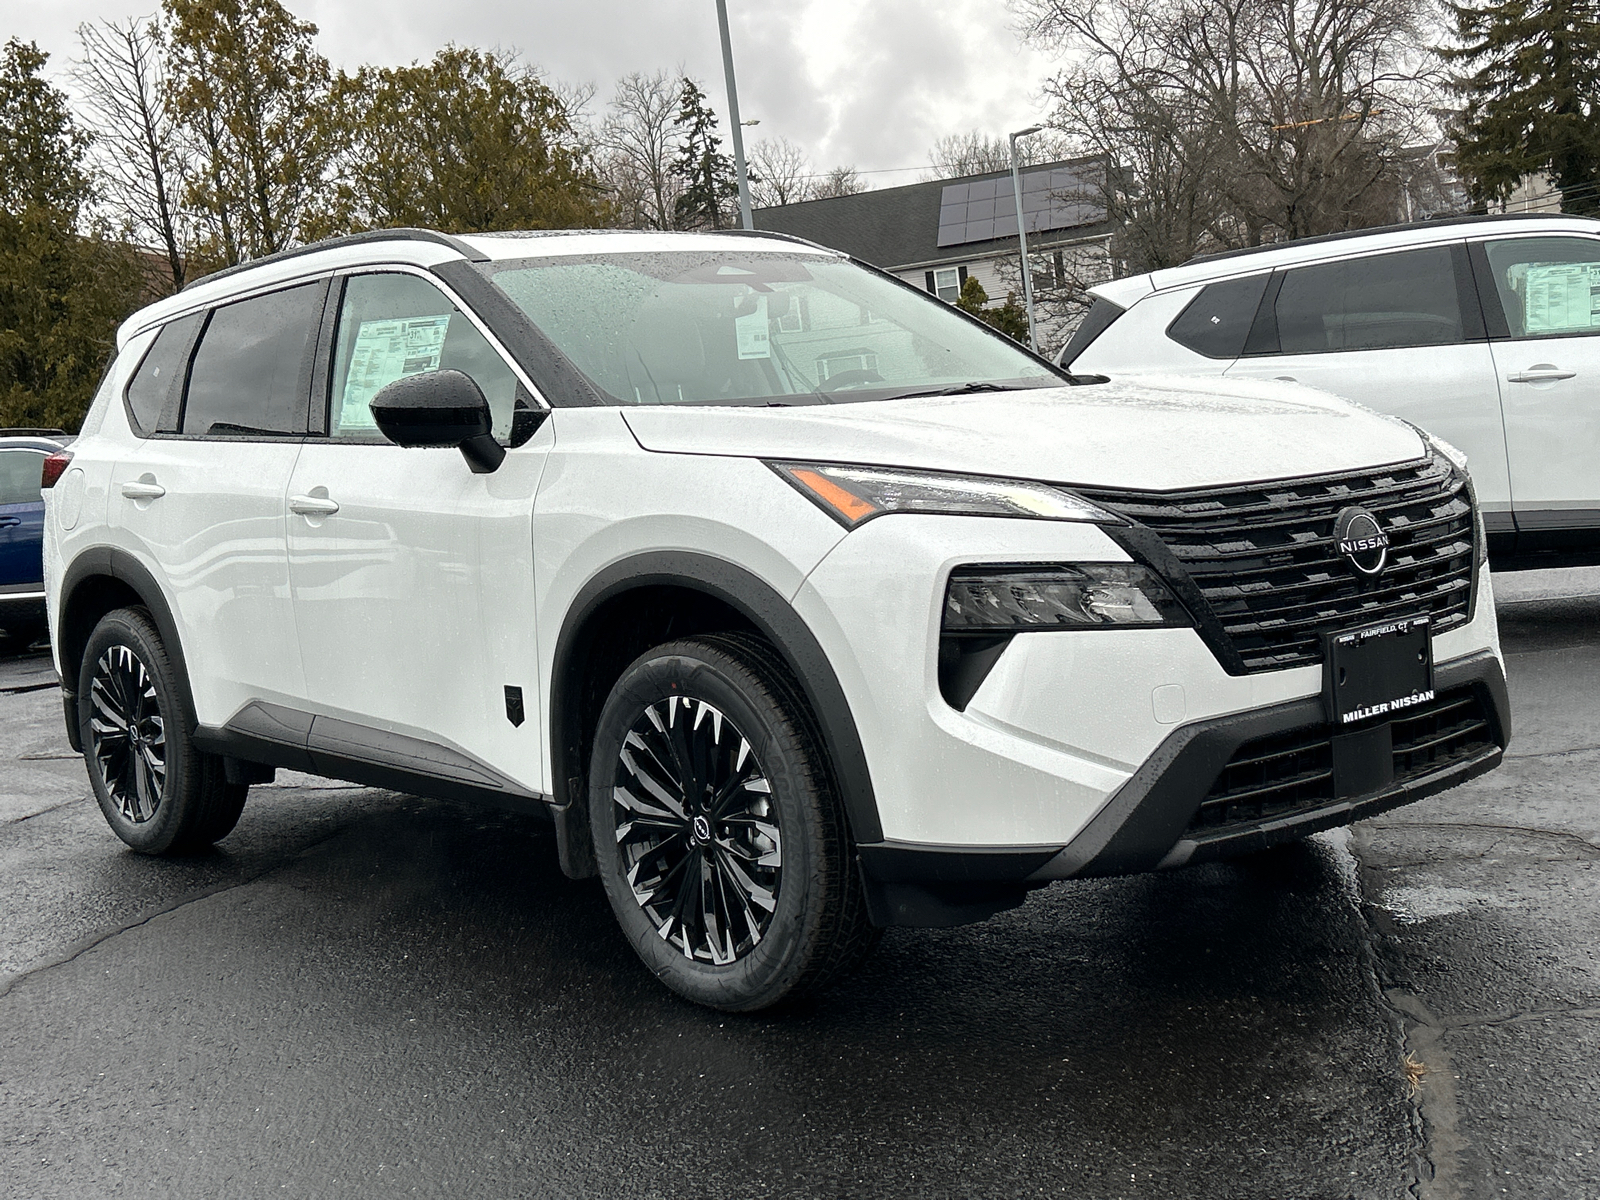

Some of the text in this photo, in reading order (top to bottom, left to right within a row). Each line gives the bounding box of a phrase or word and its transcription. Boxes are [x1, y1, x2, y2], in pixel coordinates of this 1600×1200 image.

[1340, 535, 1388, 552] NISSAN
[1360, 621, 1407, 638] FAIRFIELD, CT
[1343, 690, 1434, 723] MILLER NISSAN
